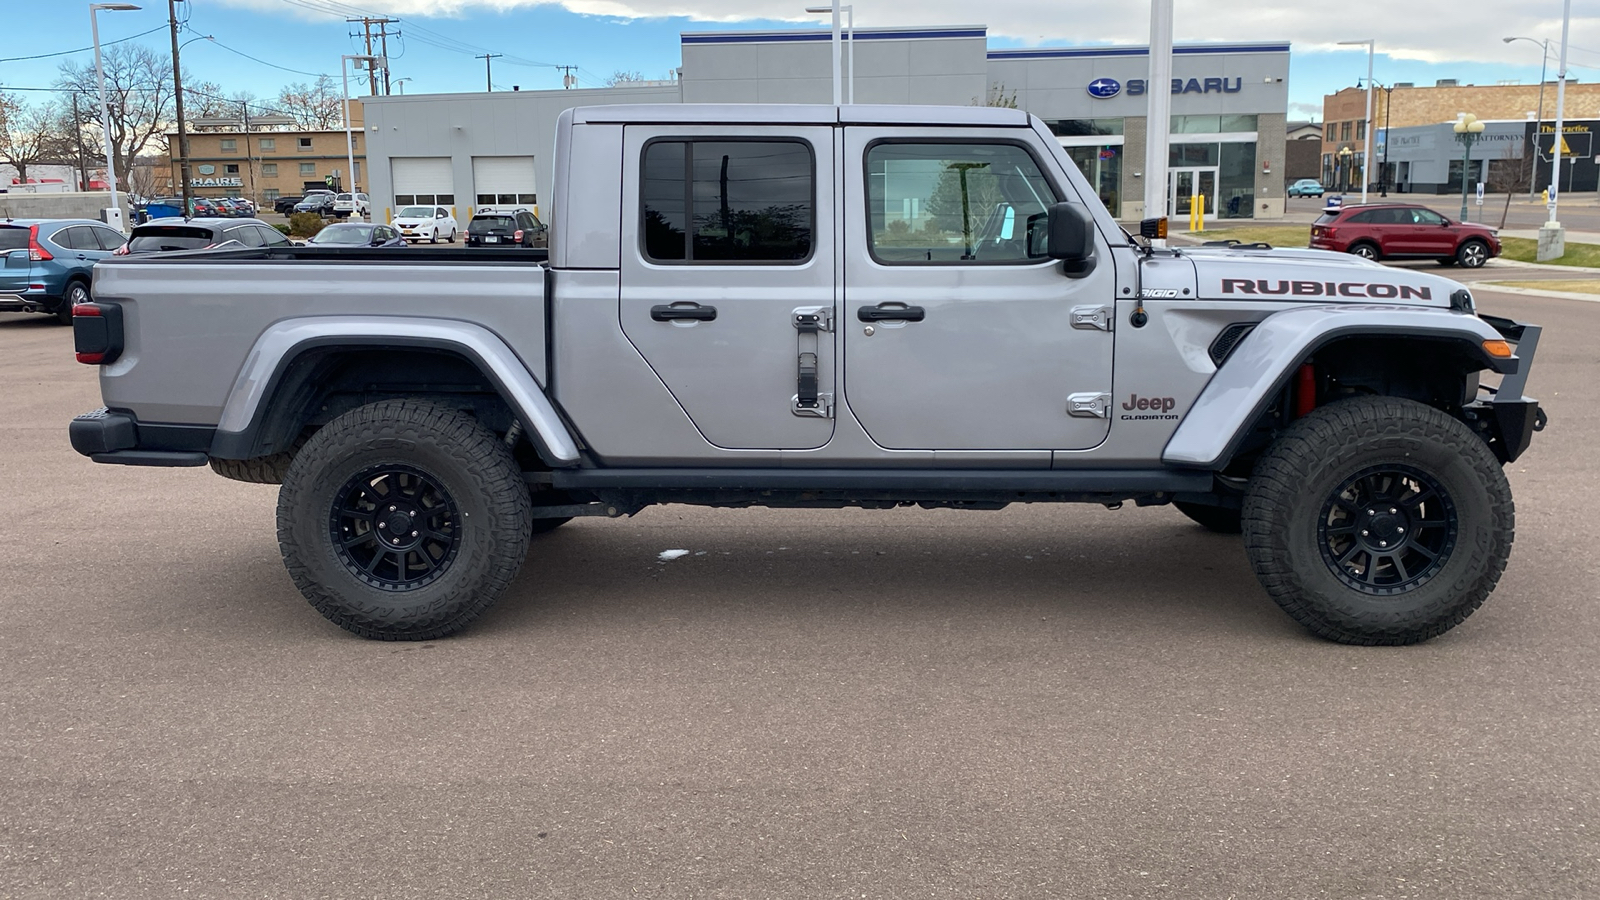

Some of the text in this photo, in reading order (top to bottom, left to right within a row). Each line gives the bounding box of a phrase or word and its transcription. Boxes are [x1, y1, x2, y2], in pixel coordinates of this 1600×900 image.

[1126, 77, 1242, 96] SBARU
[1135, 288, 1178, 298] RIGID
[1221, 278, 1432, 300] RUBICON
[1122, 393, 1175, 413] Jeep
